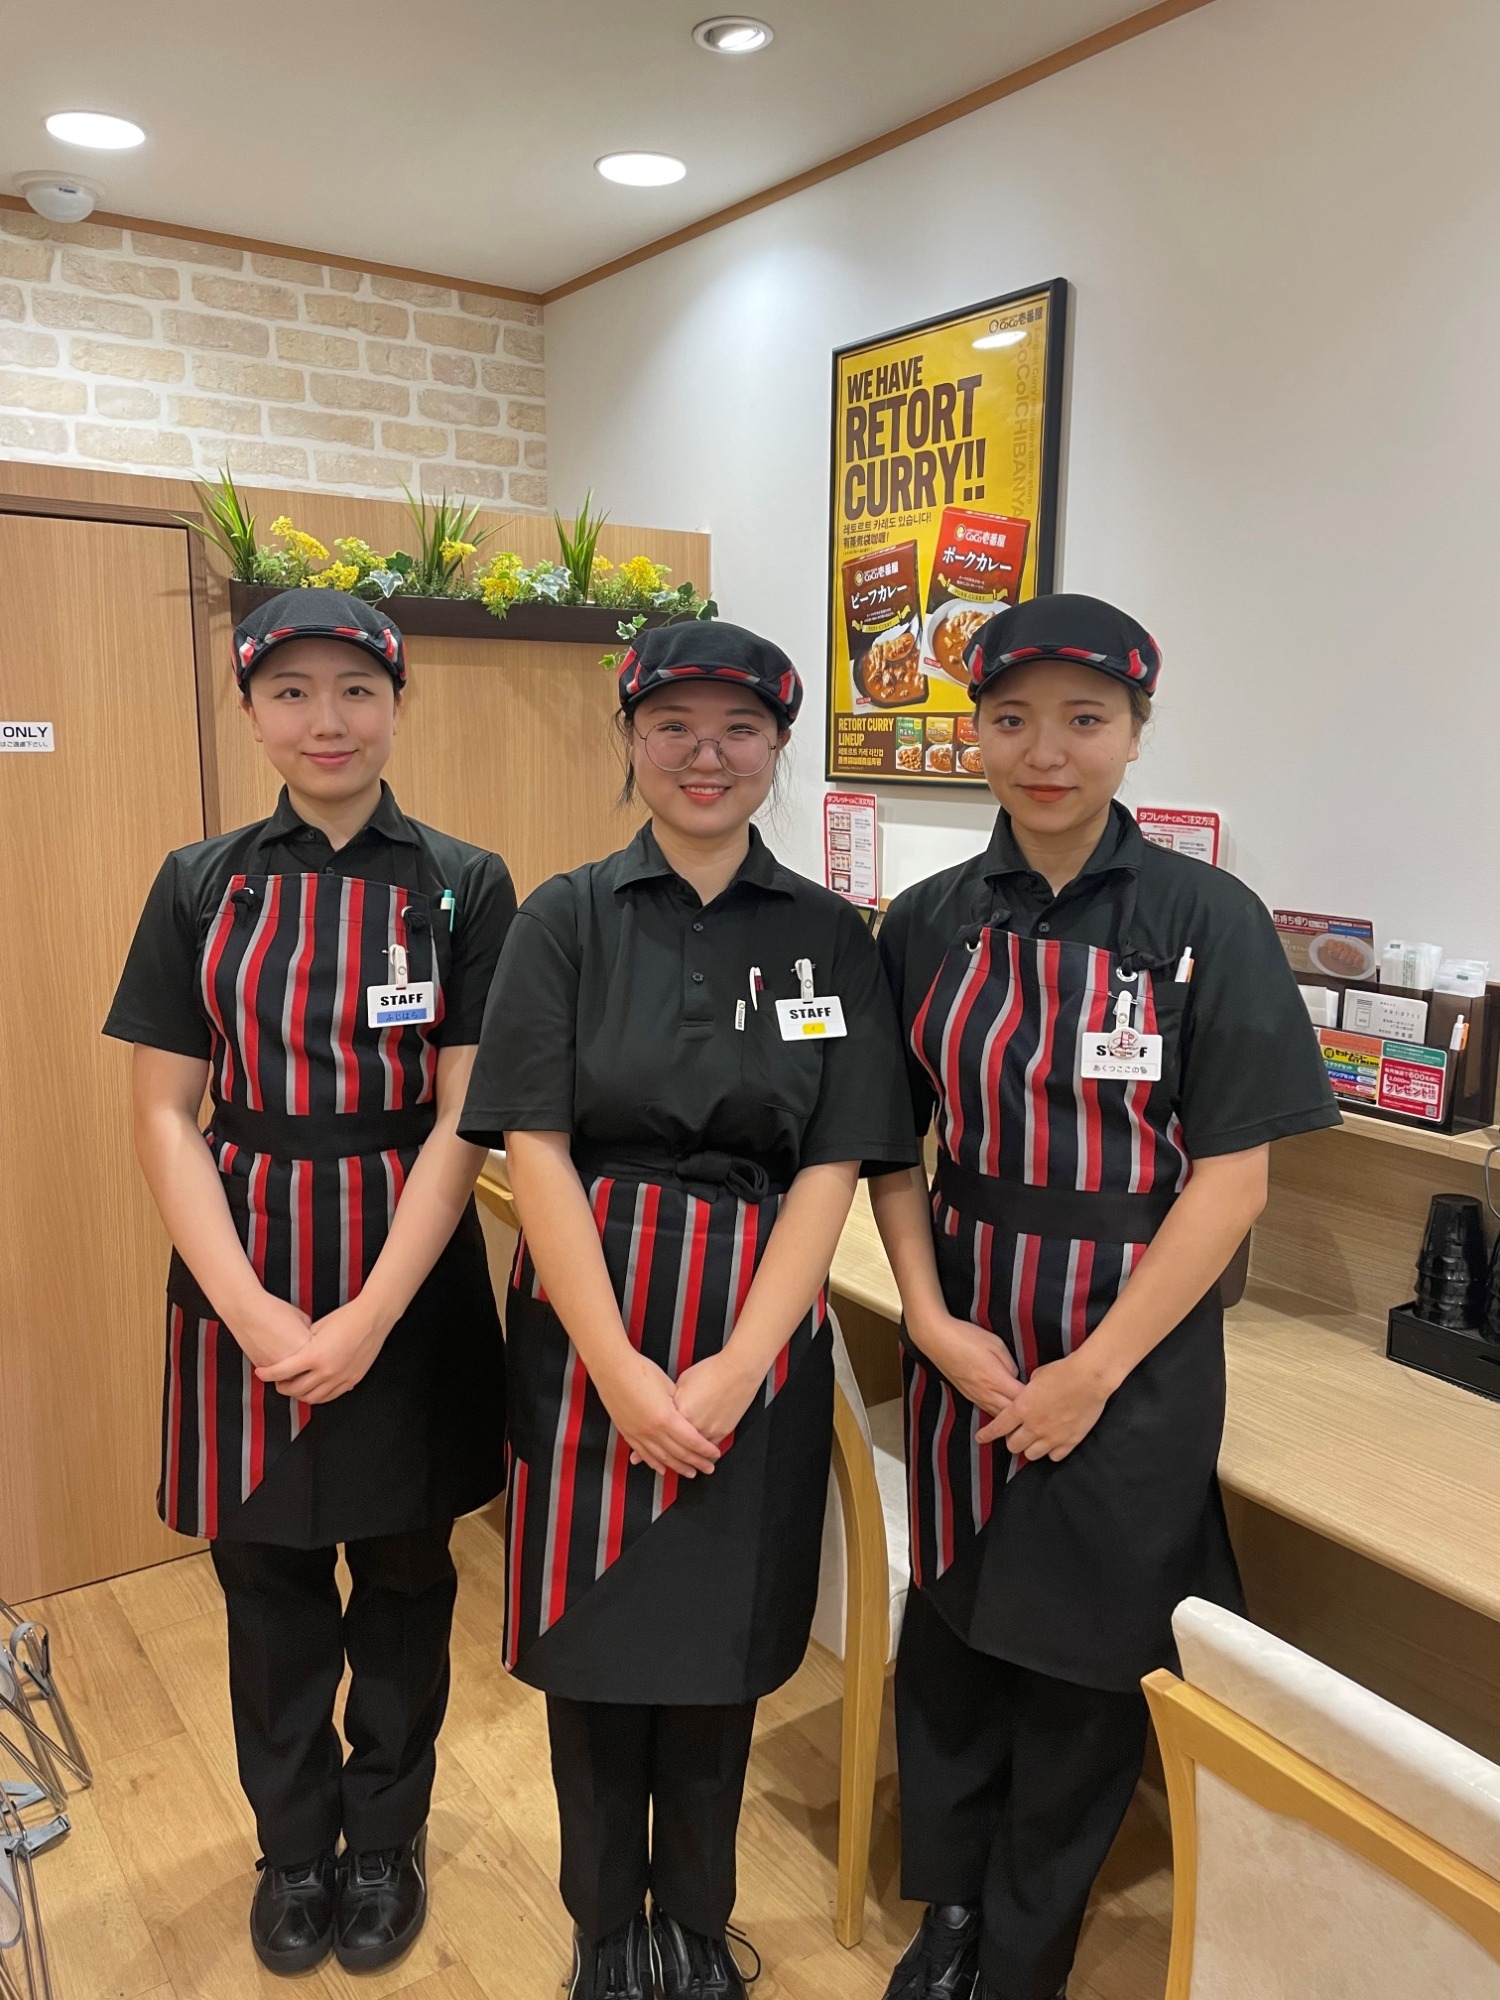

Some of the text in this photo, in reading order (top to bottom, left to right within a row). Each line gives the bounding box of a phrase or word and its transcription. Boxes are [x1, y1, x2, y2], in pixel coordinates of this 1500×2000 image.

[847, 355, 923, 404] WE HAVE
[846, 373, 982, 463] RETORT
[844, 438, 986, 521] CURRY!!
[843, 512, 932, 535] 레토르트 카레도 있습니다!
[942, 546, 1012, 572] ポークカレー
[851, 585, 908, 609] ビーフカレー
[3, 726, 48, 738] ONLY
[838, 718, 867, 731] RETORT
[867, 718, 894, 732] CURRY
[838, 733, 865, 746] LINEUP
[380, 993, 424, 1006] STAFF
[789, 1007, 831, 1019] STAFF
